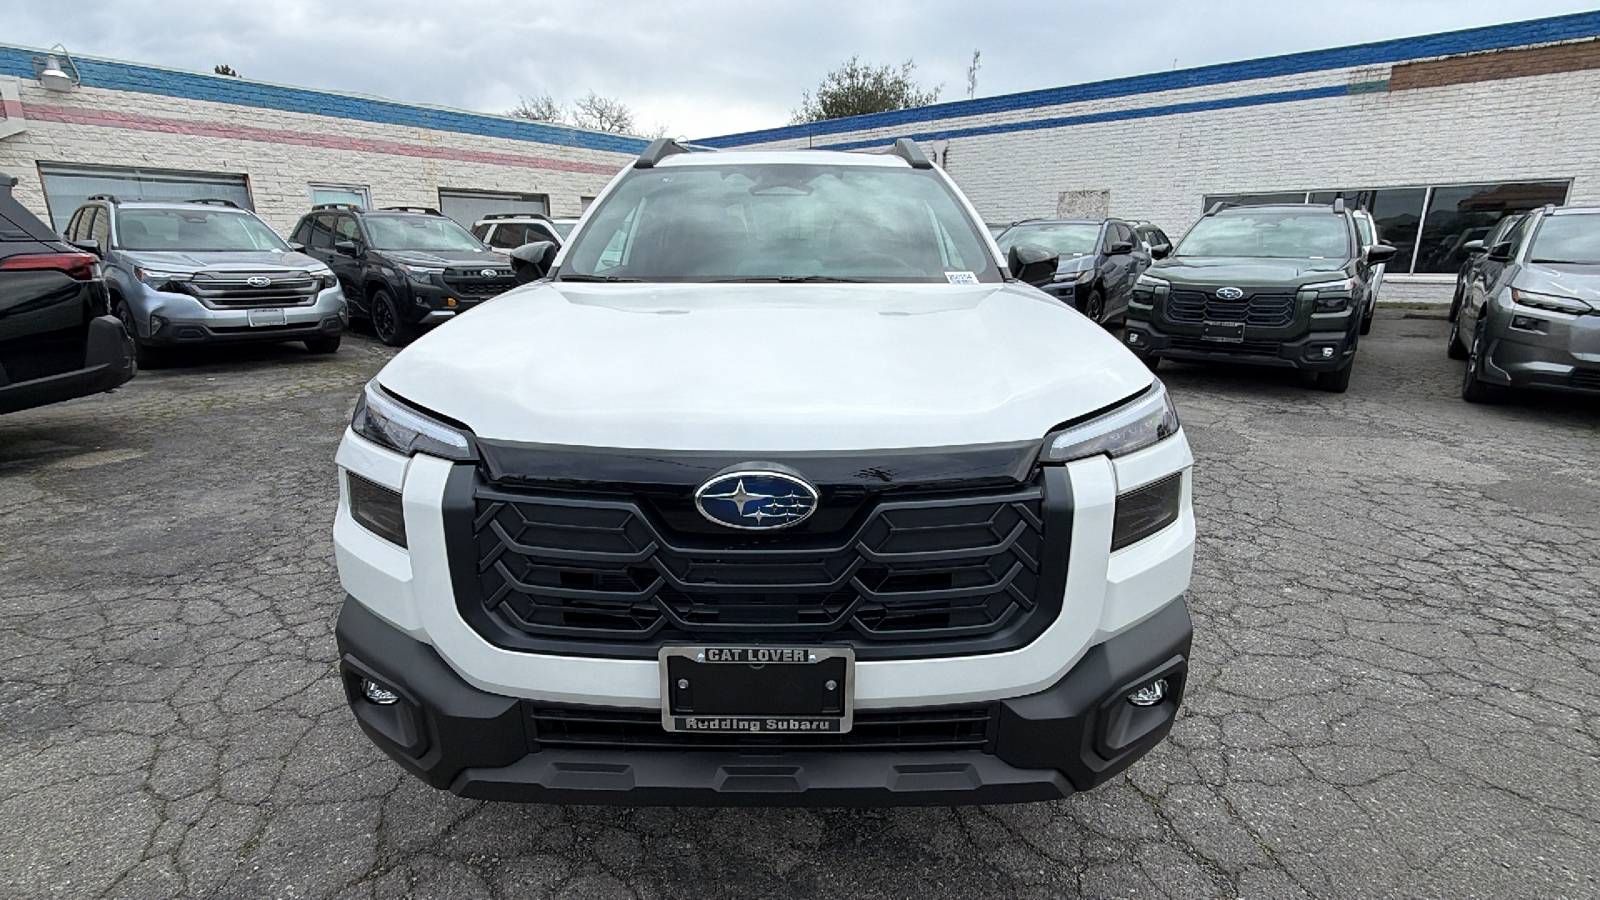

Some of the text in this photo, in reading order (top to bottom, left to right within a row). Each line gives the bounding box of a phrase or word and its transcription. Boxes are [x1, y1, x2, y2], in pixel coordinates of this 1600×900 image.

[708, 649, 805, 662] CAT LOVER
[685, 718, 830, 731] Redding Subaru
